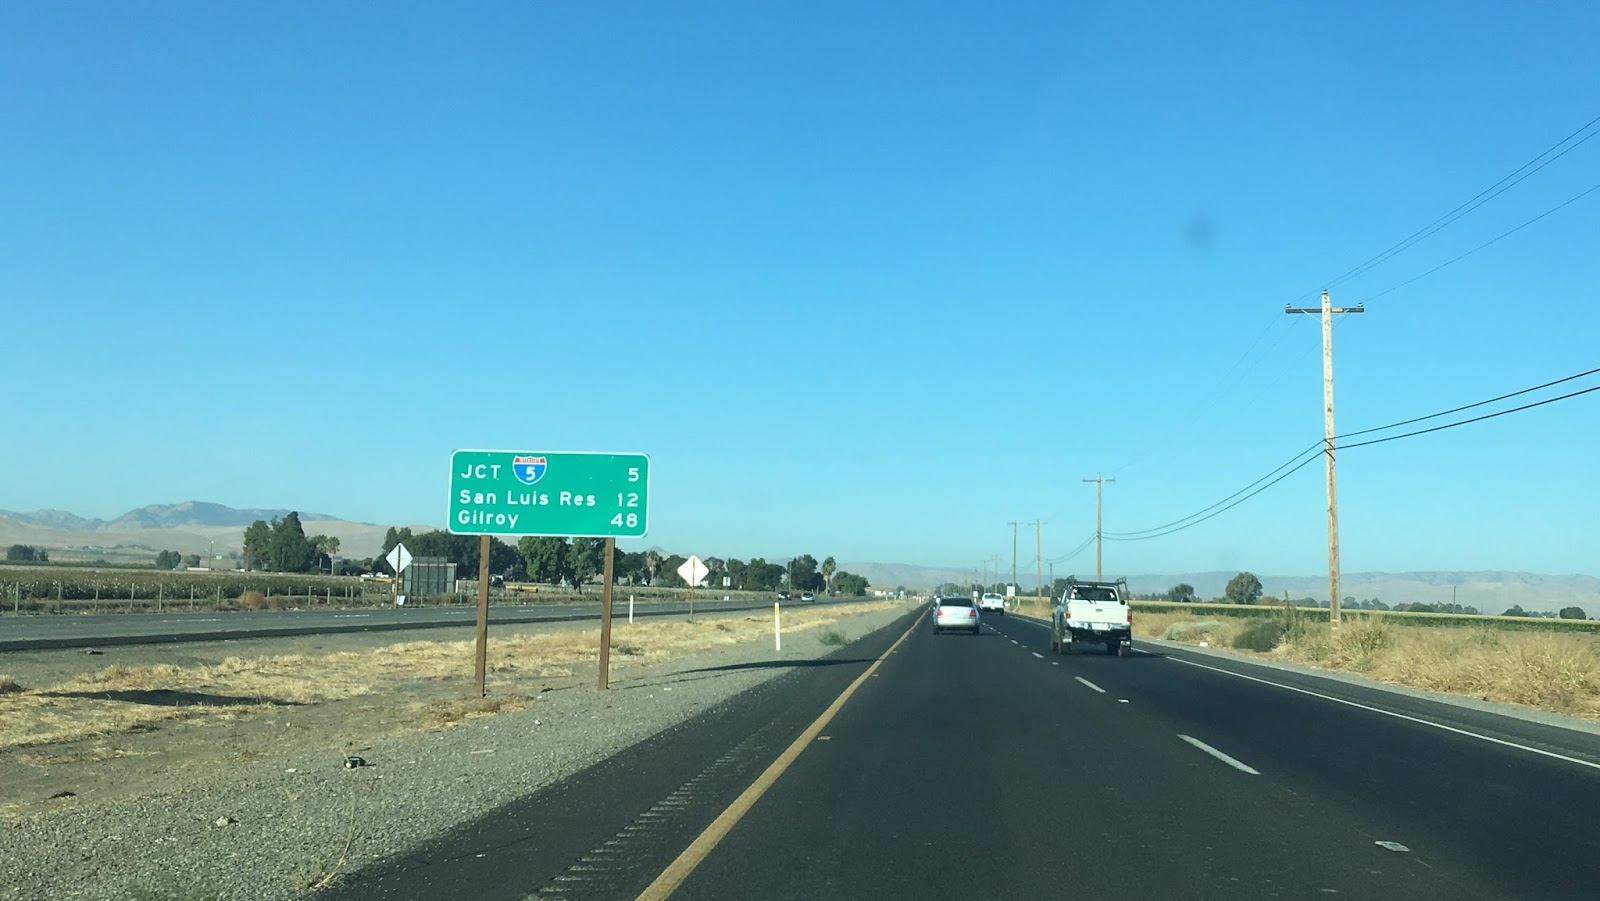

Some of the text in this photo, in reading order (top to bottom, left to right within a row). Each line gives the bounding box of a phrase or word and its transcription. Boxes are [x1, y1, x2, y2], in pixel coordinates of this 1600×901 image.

[461, 464, 501, 478] JCT
[525, 466, 536, 481] 5
[628, 468, 639, 482] 5
[460, 489, 638, 507] San Luis Res 12
[458, 510, 638, 528] Gilroy 48
